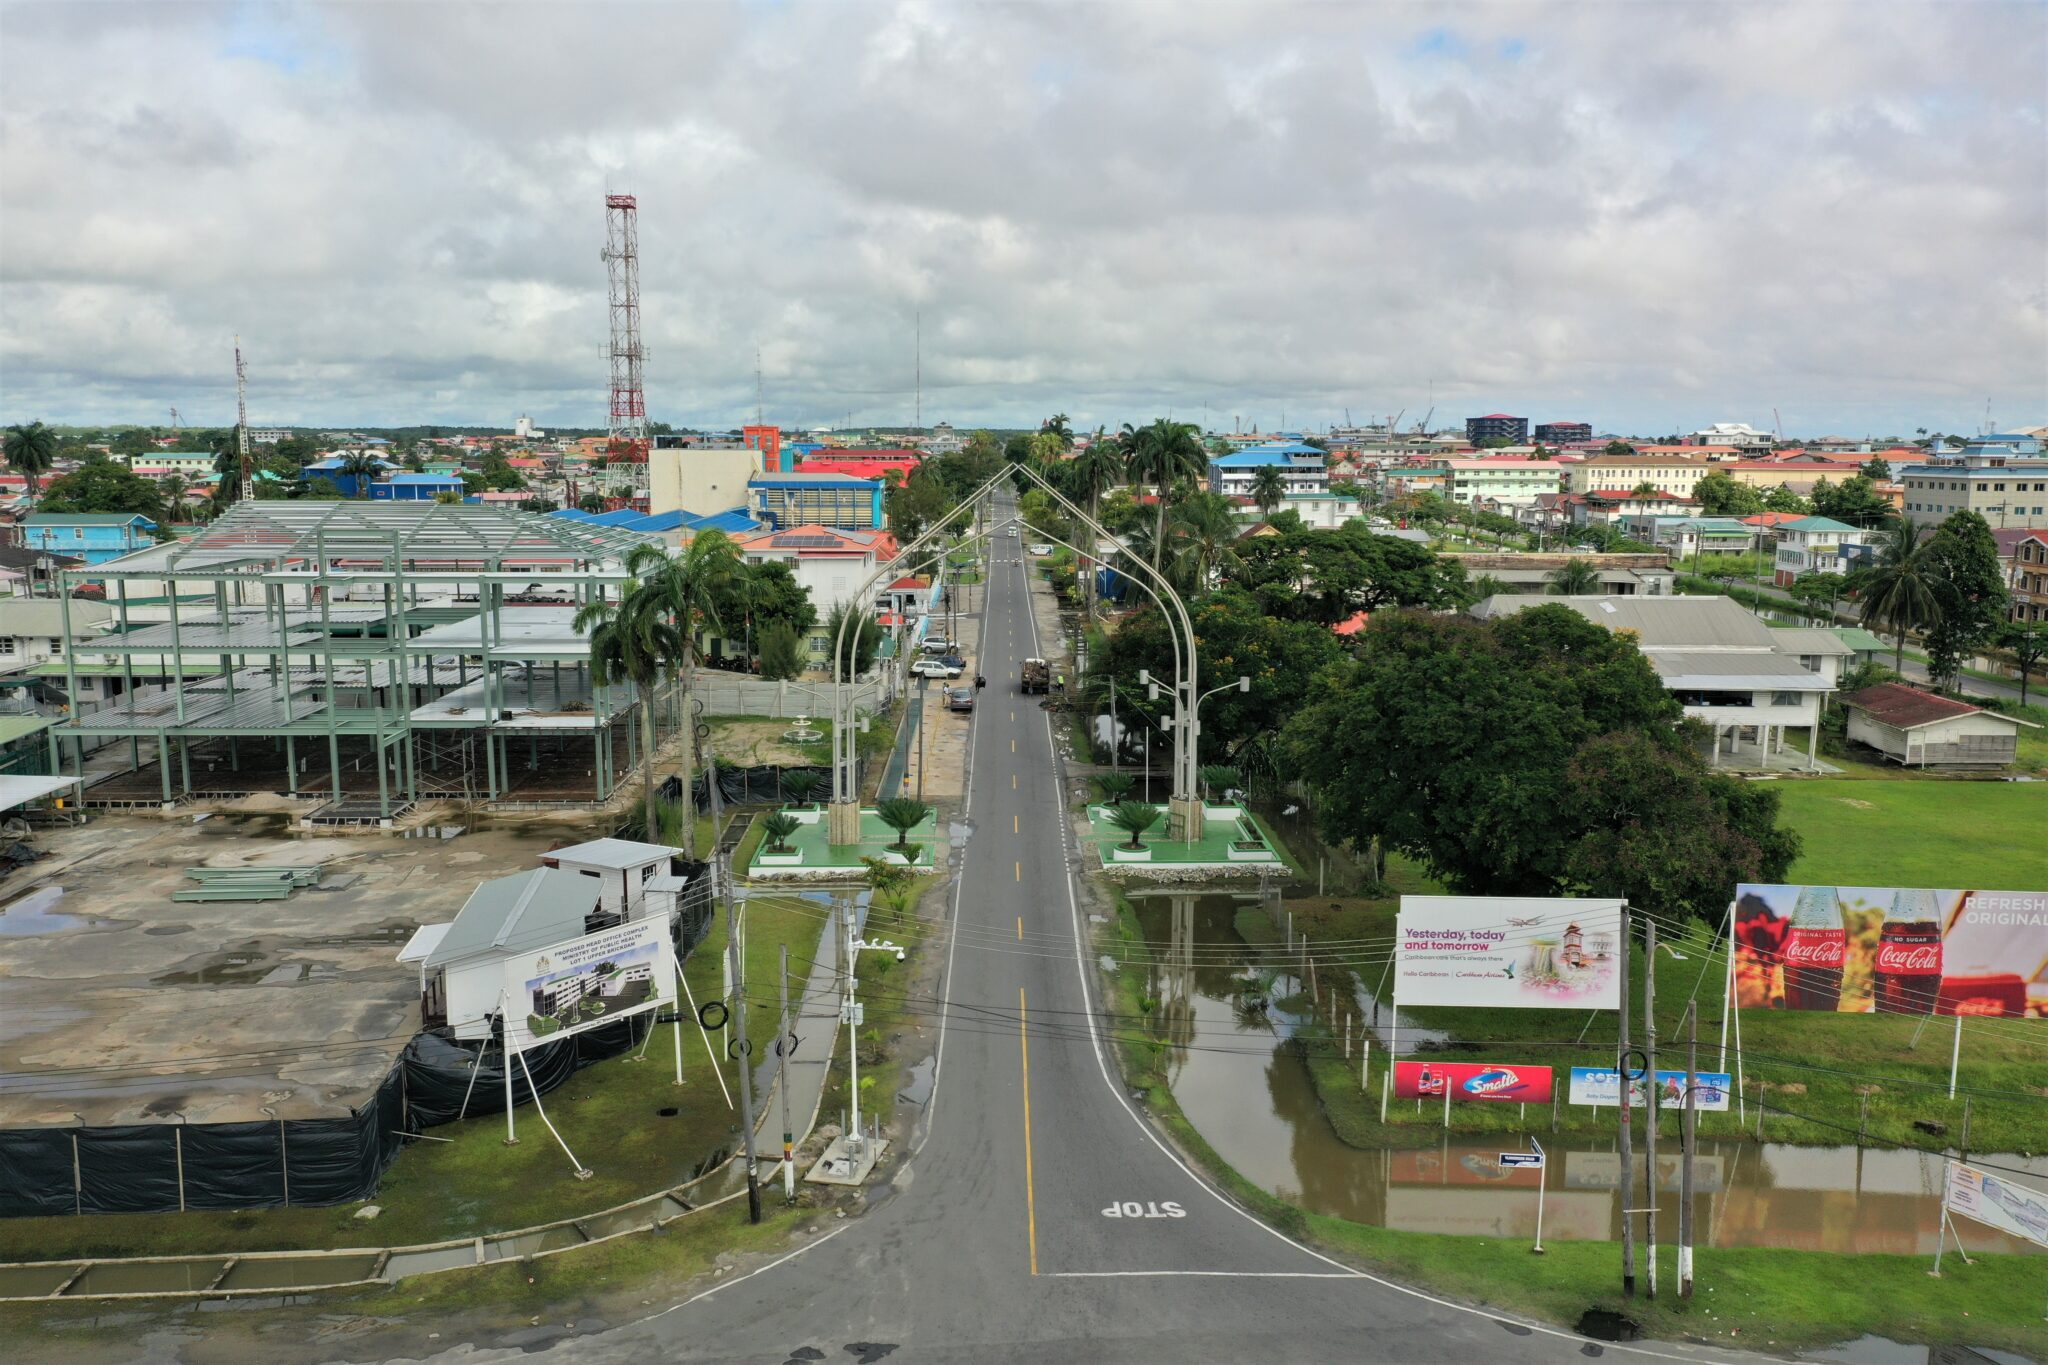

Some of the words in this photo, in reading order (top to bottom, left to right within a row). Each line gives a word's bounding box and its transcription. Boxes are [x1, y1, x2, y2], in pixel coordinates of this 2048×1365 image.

[1965, 896, 2045, 911] REFRESH
[1966, 912, 2048, 926] ORIGINAL
[555, 944, 585, 957] PROPOSED
[586, 939, 602, 948] HEAD
[602, 934, 621, 943] OFFICE
[623, 925, 648, 937] COMPLEX
[1405, 928, 1466, 941] Yesterday,
[1470, 929, 1505, 942] today
[562, 950, 589, 960] MINISTRY
[600, 940, 619, 950] PUBLIC
[621, 933, 642, 944] HEALTH
[570, 957, 581, 965] LOT
[587, 951, 606, 960] UPPER
[607, 941, 636, 954] BRICKDAM
[1404, 941, 1428, 950] and
[1431, 941, 1489, 951] tomorrow
[1786, 940, 1844, 962] Coca-Cola
[1879, 945, 1939, 969] Coca-Cola
[1471, 1073, 1519, 1094] Smalta
[1101, 1201, 1187, 1218] STOP
